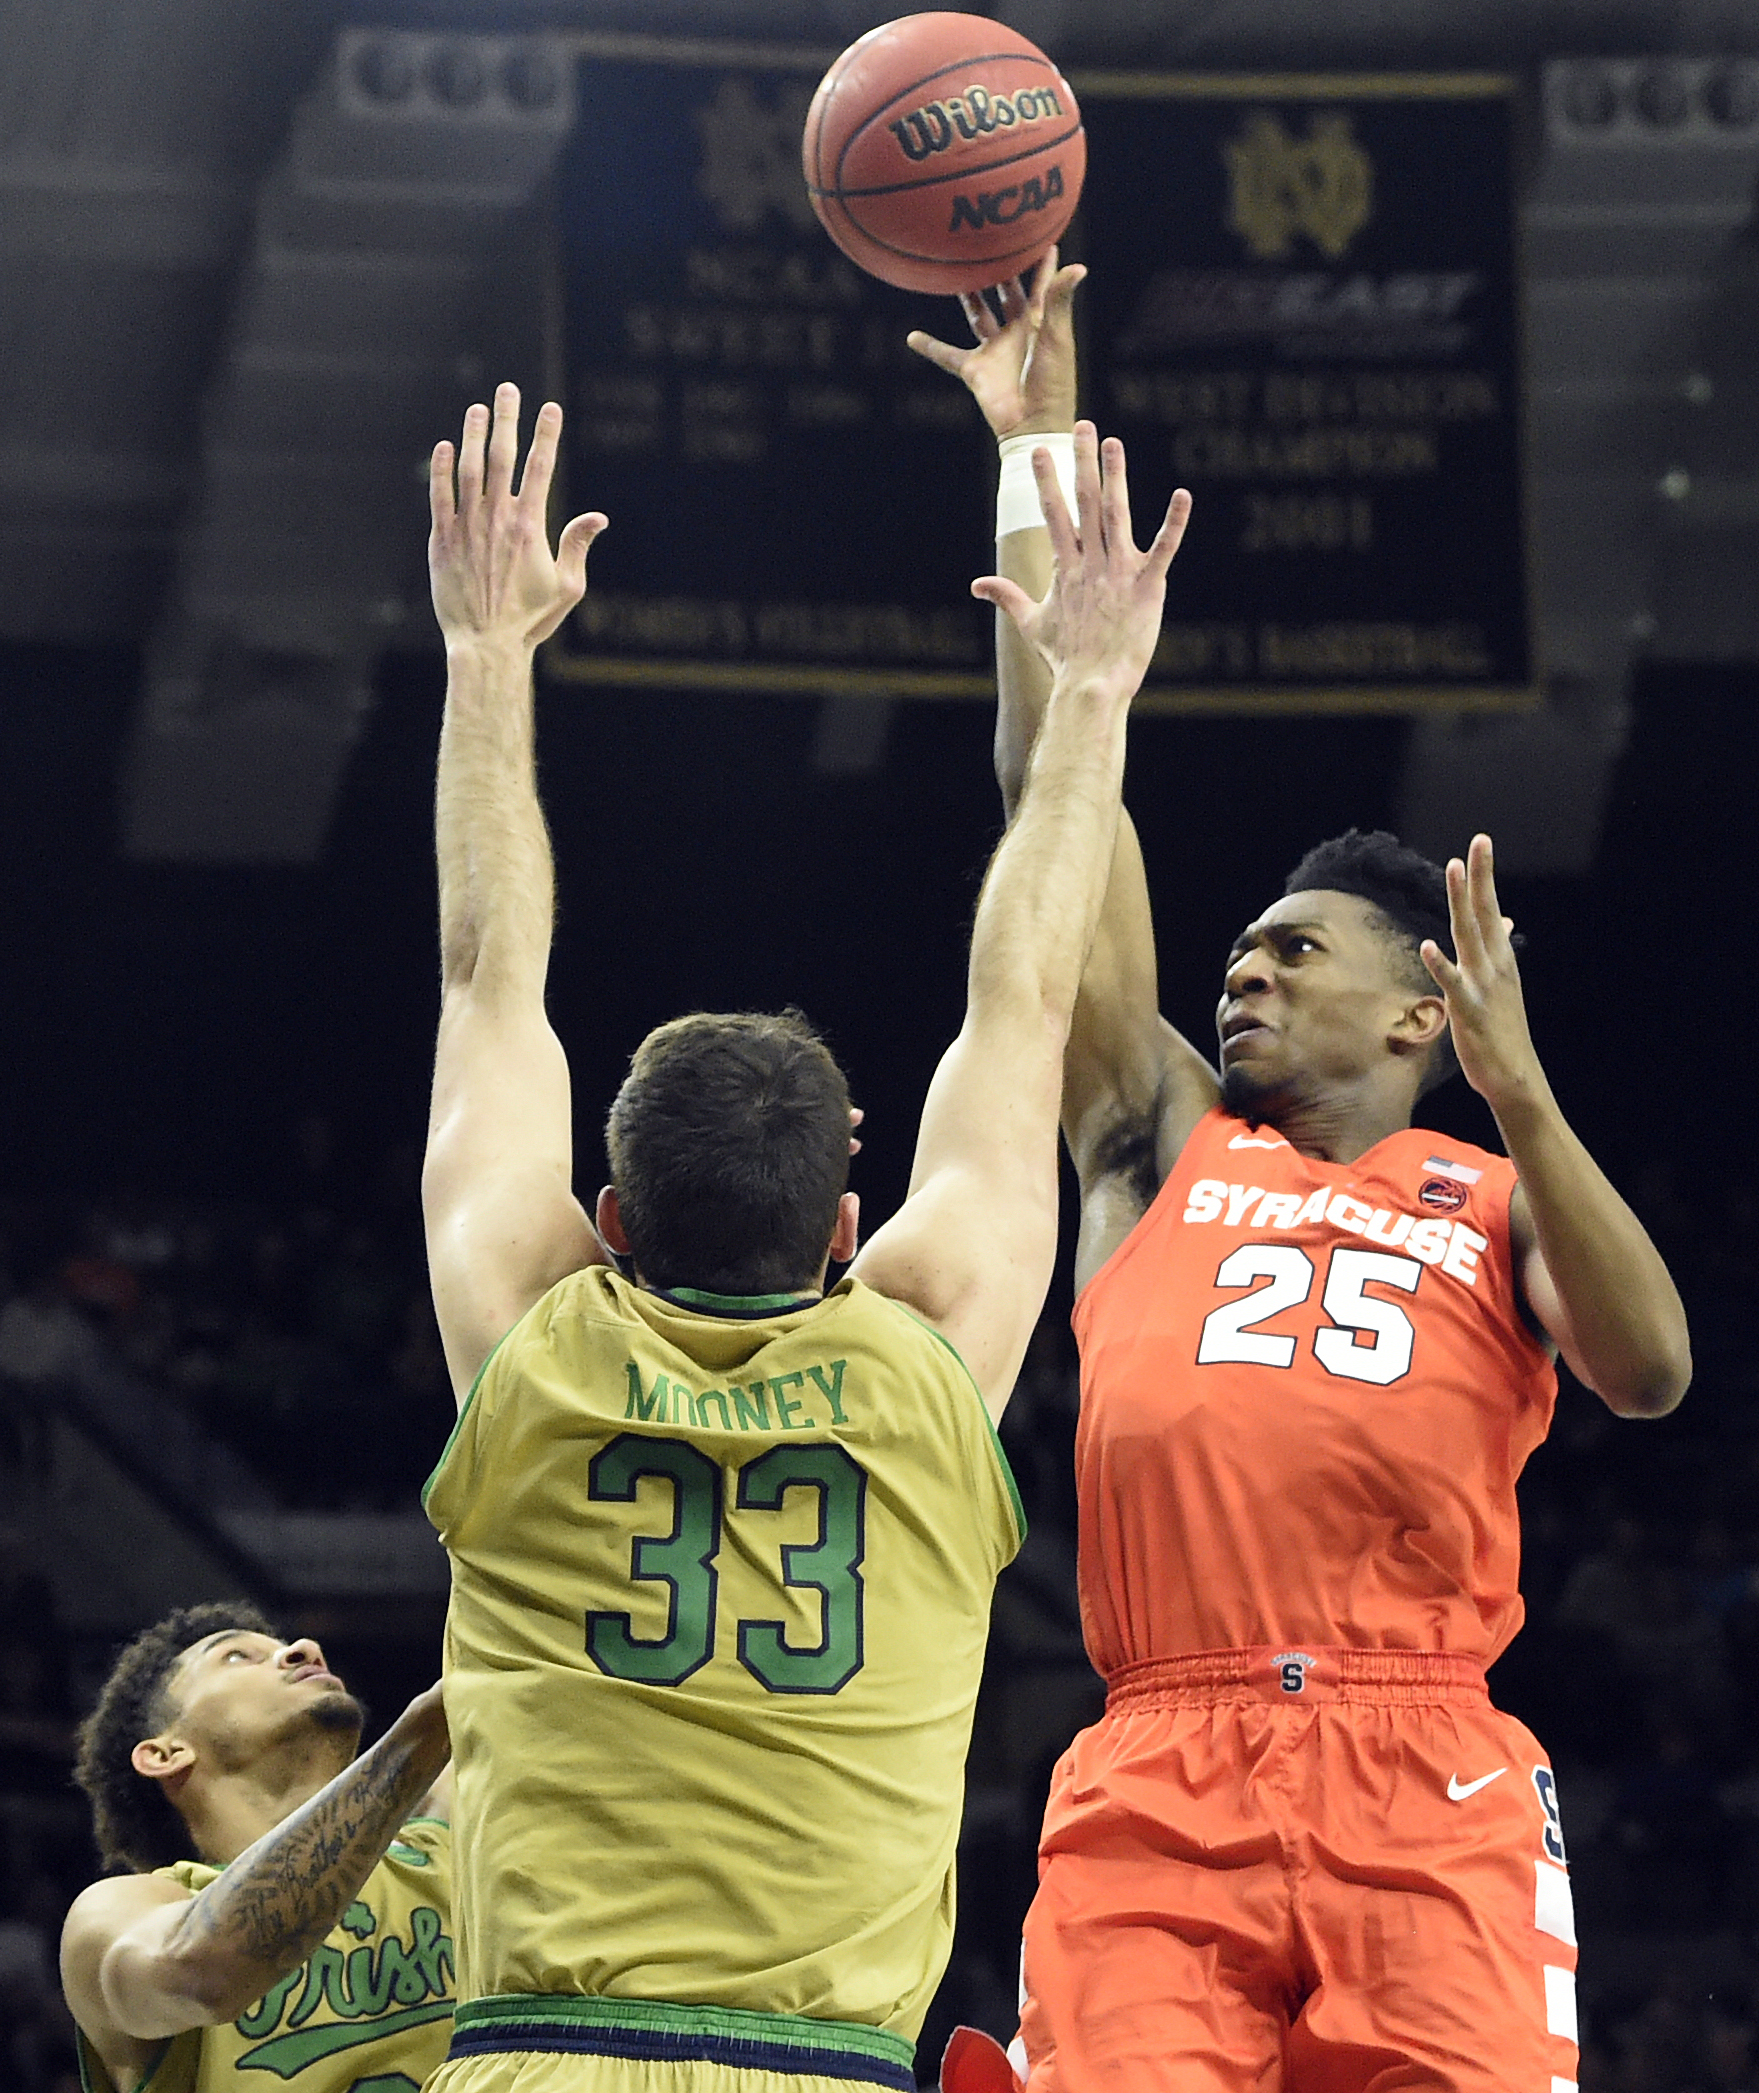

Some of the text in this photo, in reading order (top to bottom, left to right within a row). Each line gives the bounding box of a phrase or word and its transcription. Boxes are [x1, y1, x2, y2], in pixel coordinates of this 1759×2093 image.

[889, 84, 1064, 162] Wilson
[949, 165, 1065, 232] NCAA
[1183, 1179, 1488, 1286] SYRACUSE
[1195, 1243, 1423, 1386] 25
[624, 1360, 849, 1432] MOONEY
[584, 1432, 868, 1696] 33
